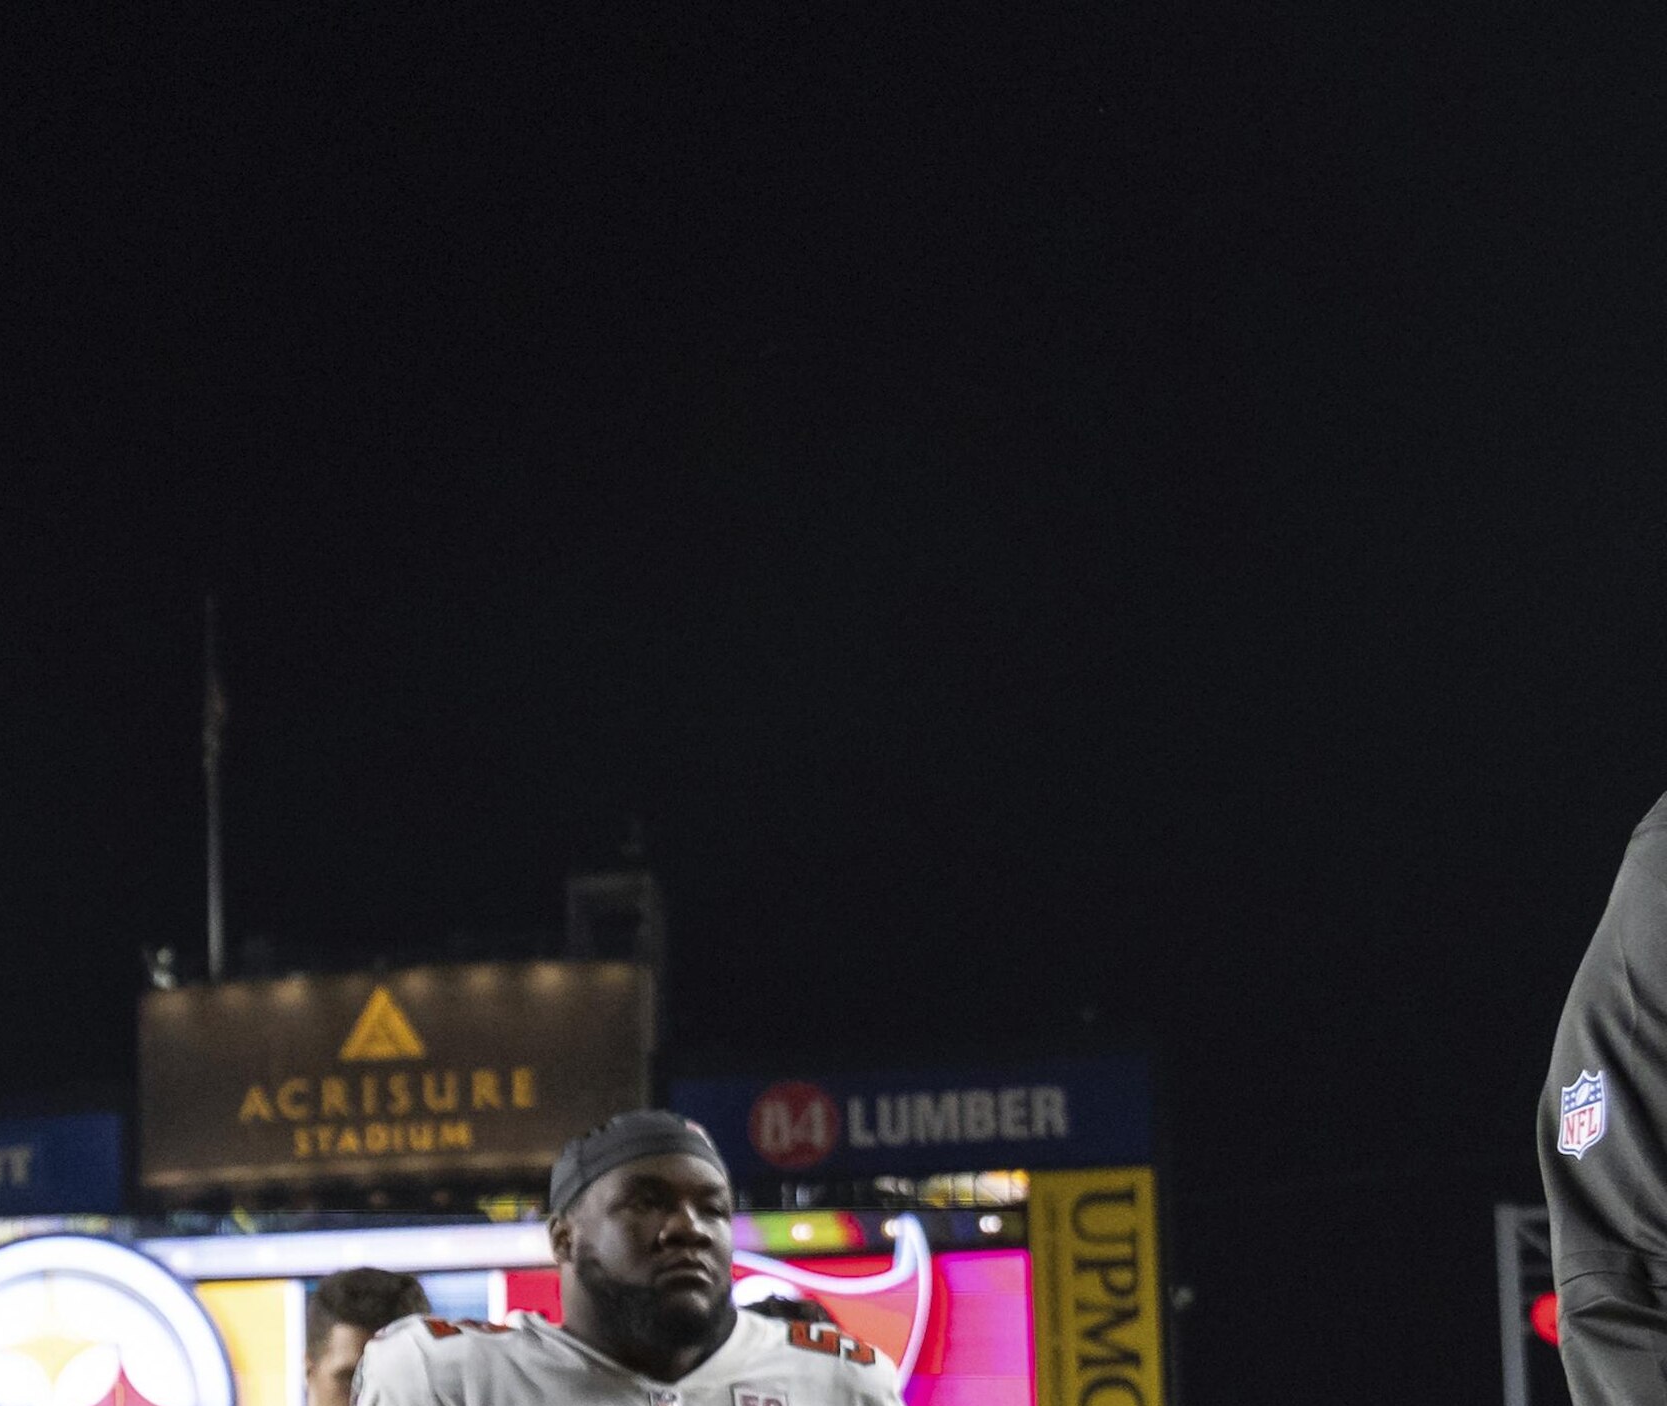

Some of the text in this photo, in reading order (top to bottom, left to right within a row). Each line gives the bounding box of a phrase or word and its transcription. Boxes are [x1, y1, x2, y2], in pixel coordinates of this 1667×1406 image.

[238, 1066, 534, 1122] ACRISURE
[847, 1085, 1067, 1148] LUMBER
[292, 1120, 471, 1158] STADIUM
[1563, 1105, 1598, 1145] NFL
